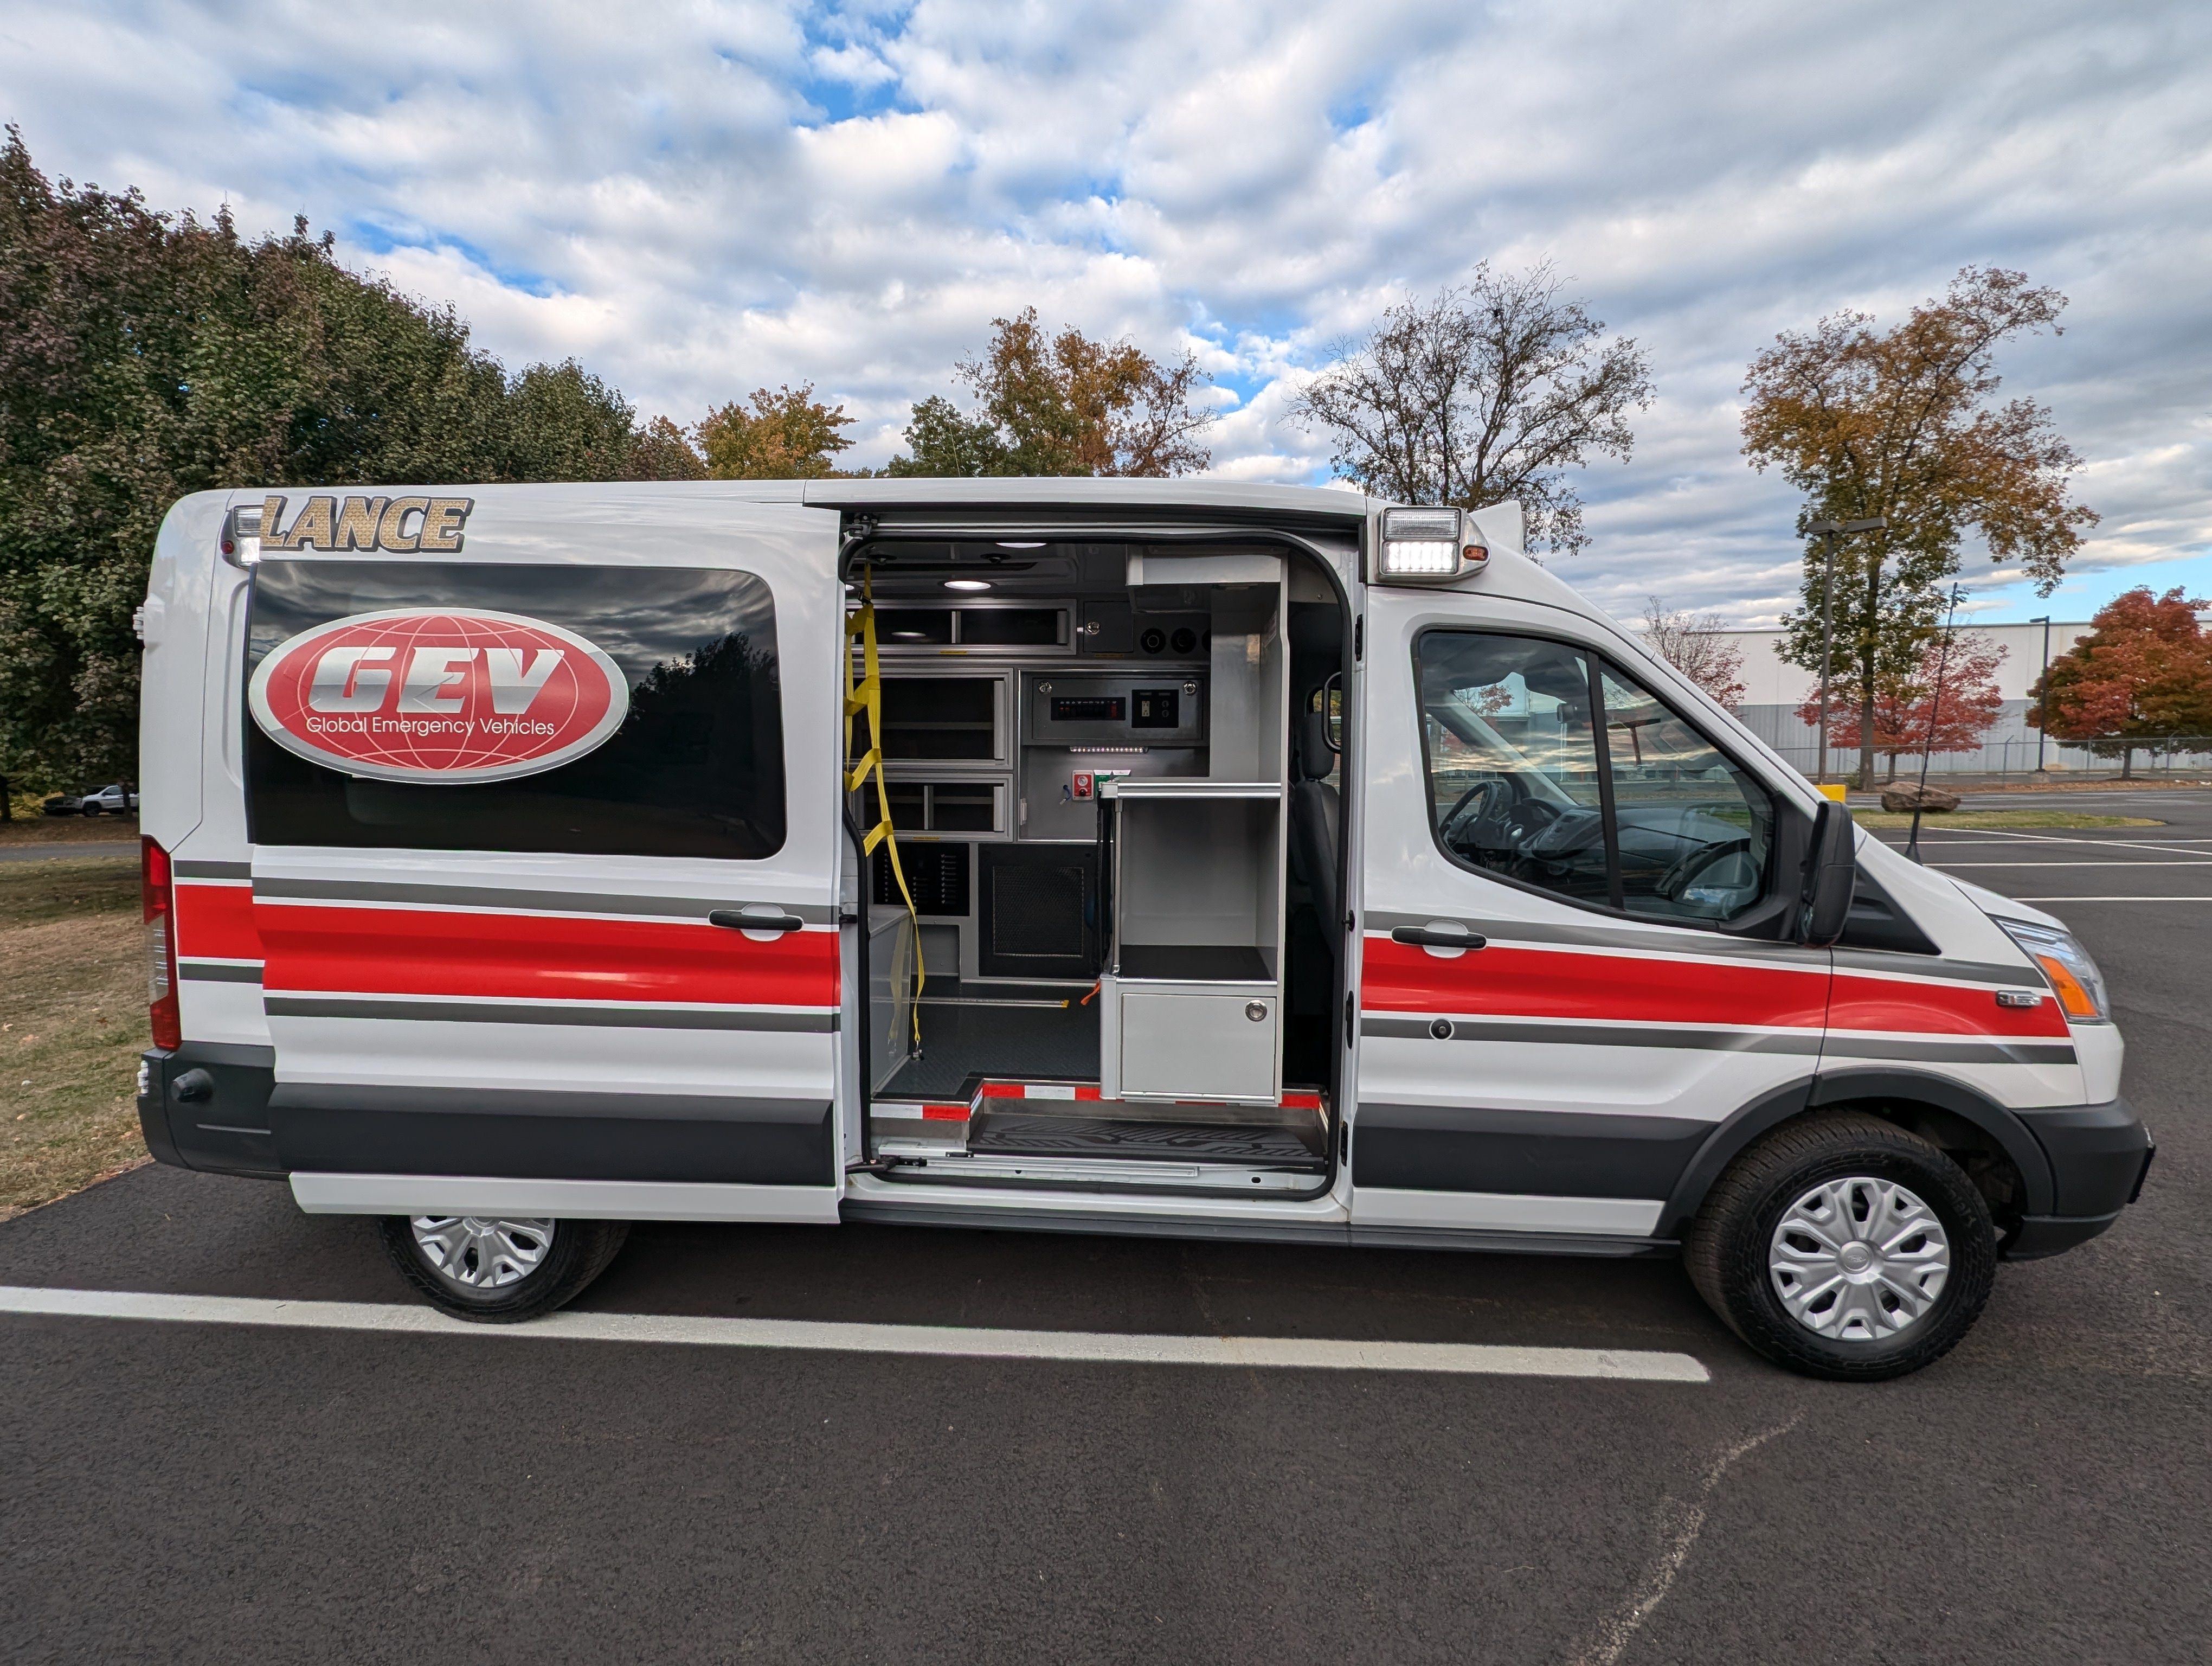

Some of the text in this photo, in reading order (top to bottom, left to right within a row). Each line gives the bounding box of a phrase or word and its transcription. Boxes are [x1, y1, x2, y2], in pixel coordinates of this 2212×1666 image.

[260, 495, 474, 553] LANCE
[308, 646, 564, 714] GEV
[306, 716, 555, 737] Global Emergency Vehicles
